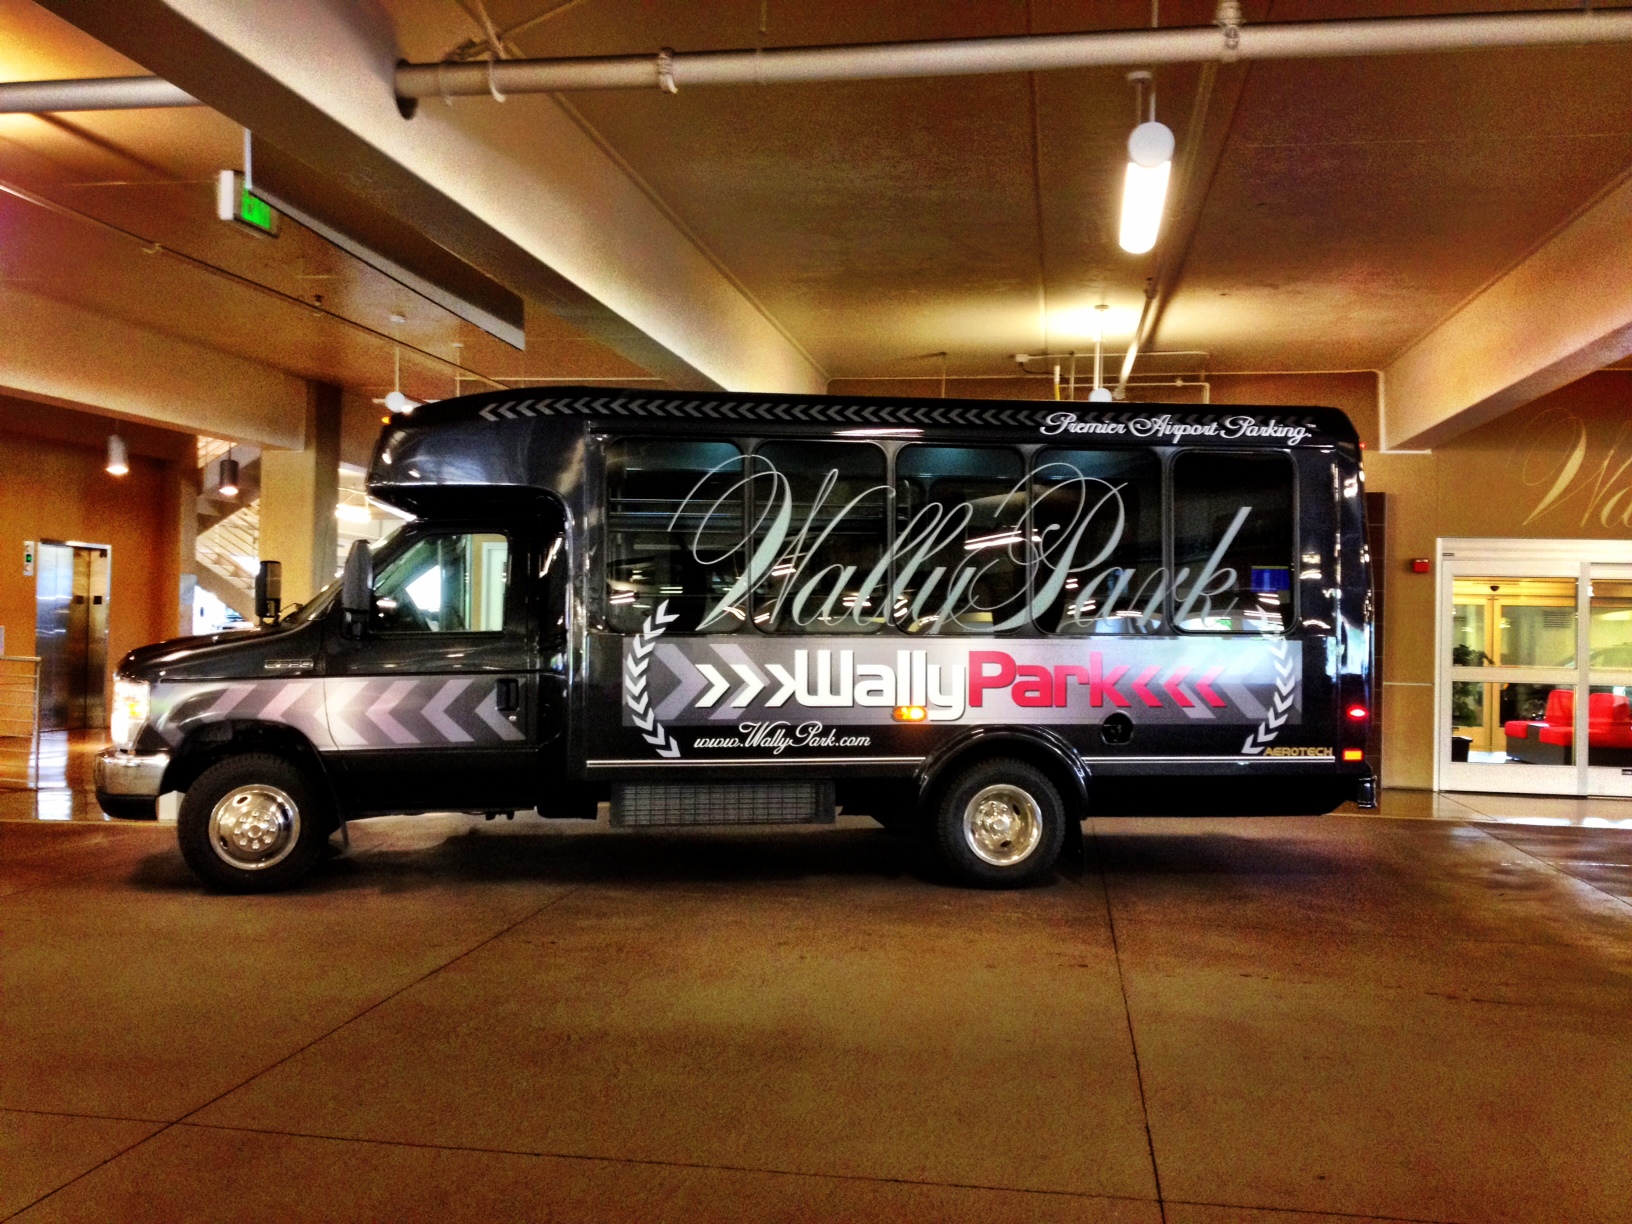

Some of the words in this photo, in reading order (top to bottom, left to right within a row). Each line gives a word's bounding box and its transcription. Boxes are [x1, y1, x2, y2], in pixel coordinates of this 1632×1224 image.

[1040, 412, 1127, 435] Premier
[1128, 414, 1219, 444] Airport
[693, 720, 871, 755] www.WallyPark.com
[1263, 746, 1333, 757] AEROTECH
